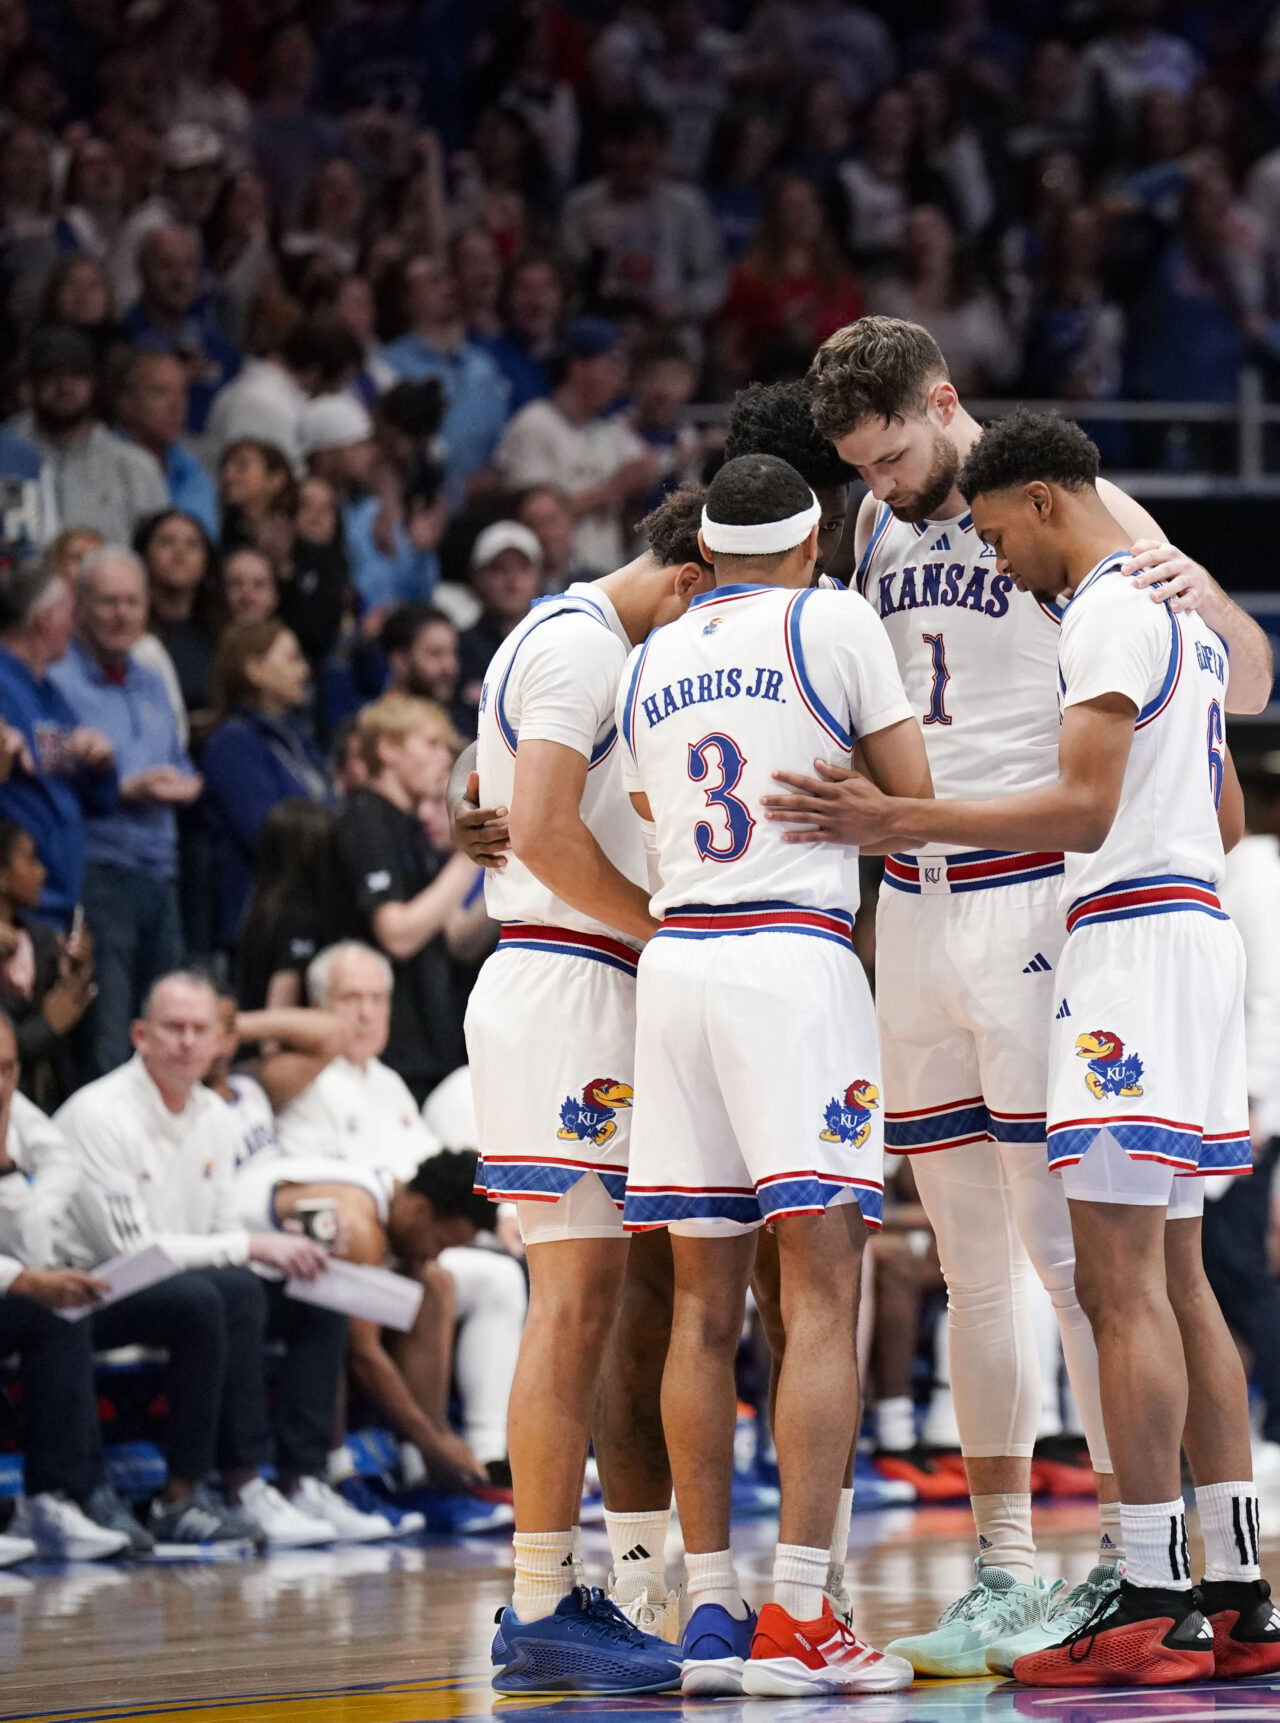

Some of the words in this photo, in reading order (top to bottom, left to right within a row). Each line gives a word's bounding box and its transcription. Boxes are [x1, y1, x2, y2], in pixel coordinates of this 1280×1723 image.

[879, 562, 1013, 619] KANSAS
[641, 667, 742, 728] HARRIS
[746, 667, 787, 704] JR.
[922, 633, 953, 726] 1
[687, 732, 757, 863] 3
[924, 867, 942, 884] KU
[1106, 1066, 1126, 1081] KU
[577, 1110, 598, 1127] KU
[840, 1113, 858, 1129] KU
